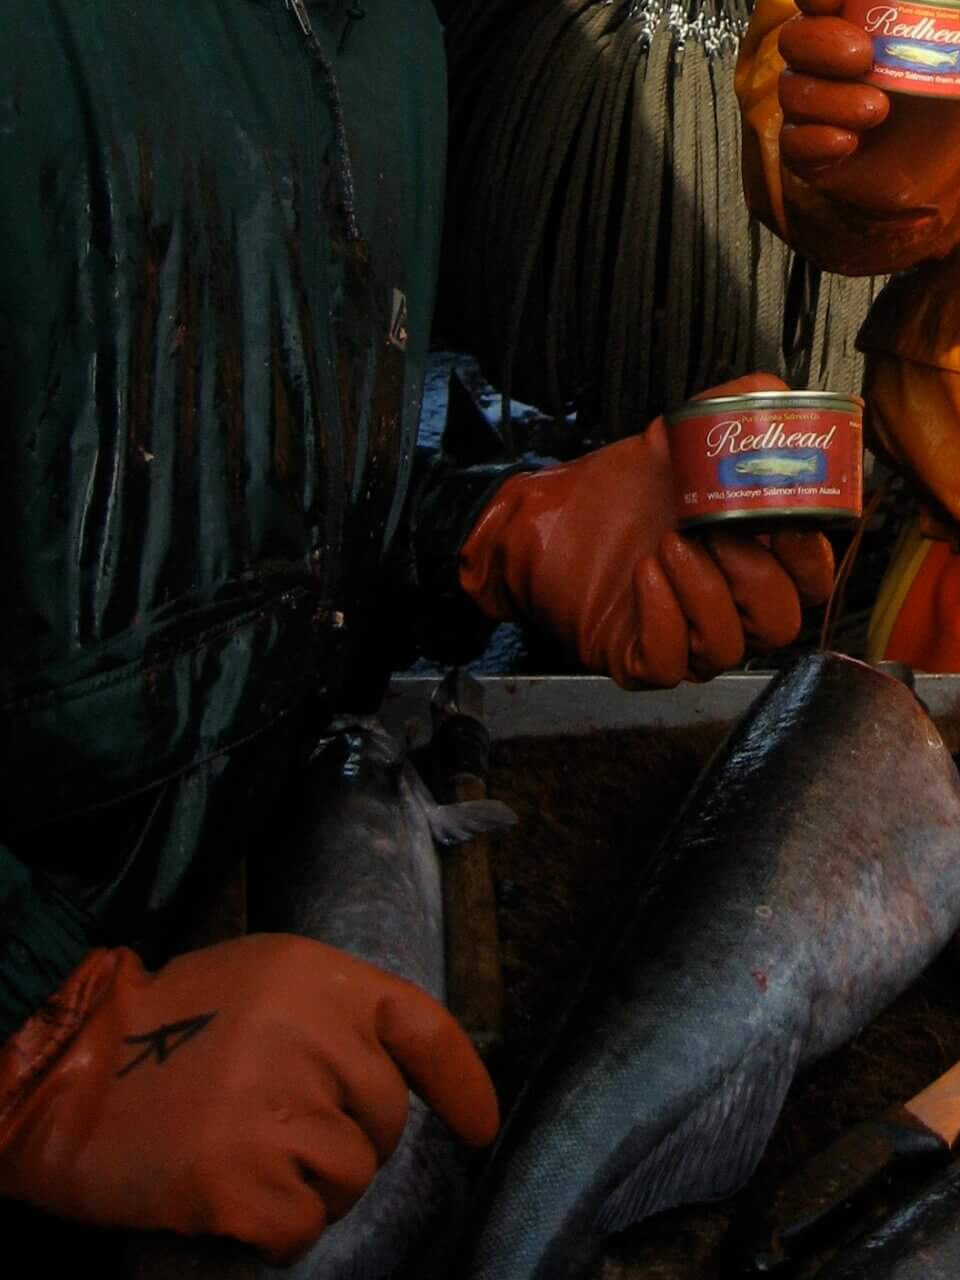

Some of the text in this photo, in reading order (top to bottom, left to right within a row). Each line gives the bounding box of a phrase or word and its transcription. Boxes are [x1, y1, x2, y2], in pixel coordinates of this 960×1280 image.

[905, 71, 934, 83] Salmon
[706, 420, 837, 457] Redhead
[707, 491, 725, 501] Wild
[726, 489, 761, 499] Sockeye
[763, 486, 796, 496] Salmon
[798, 486, 818, 496] from
[819, 487, 841, 496] Alaska
